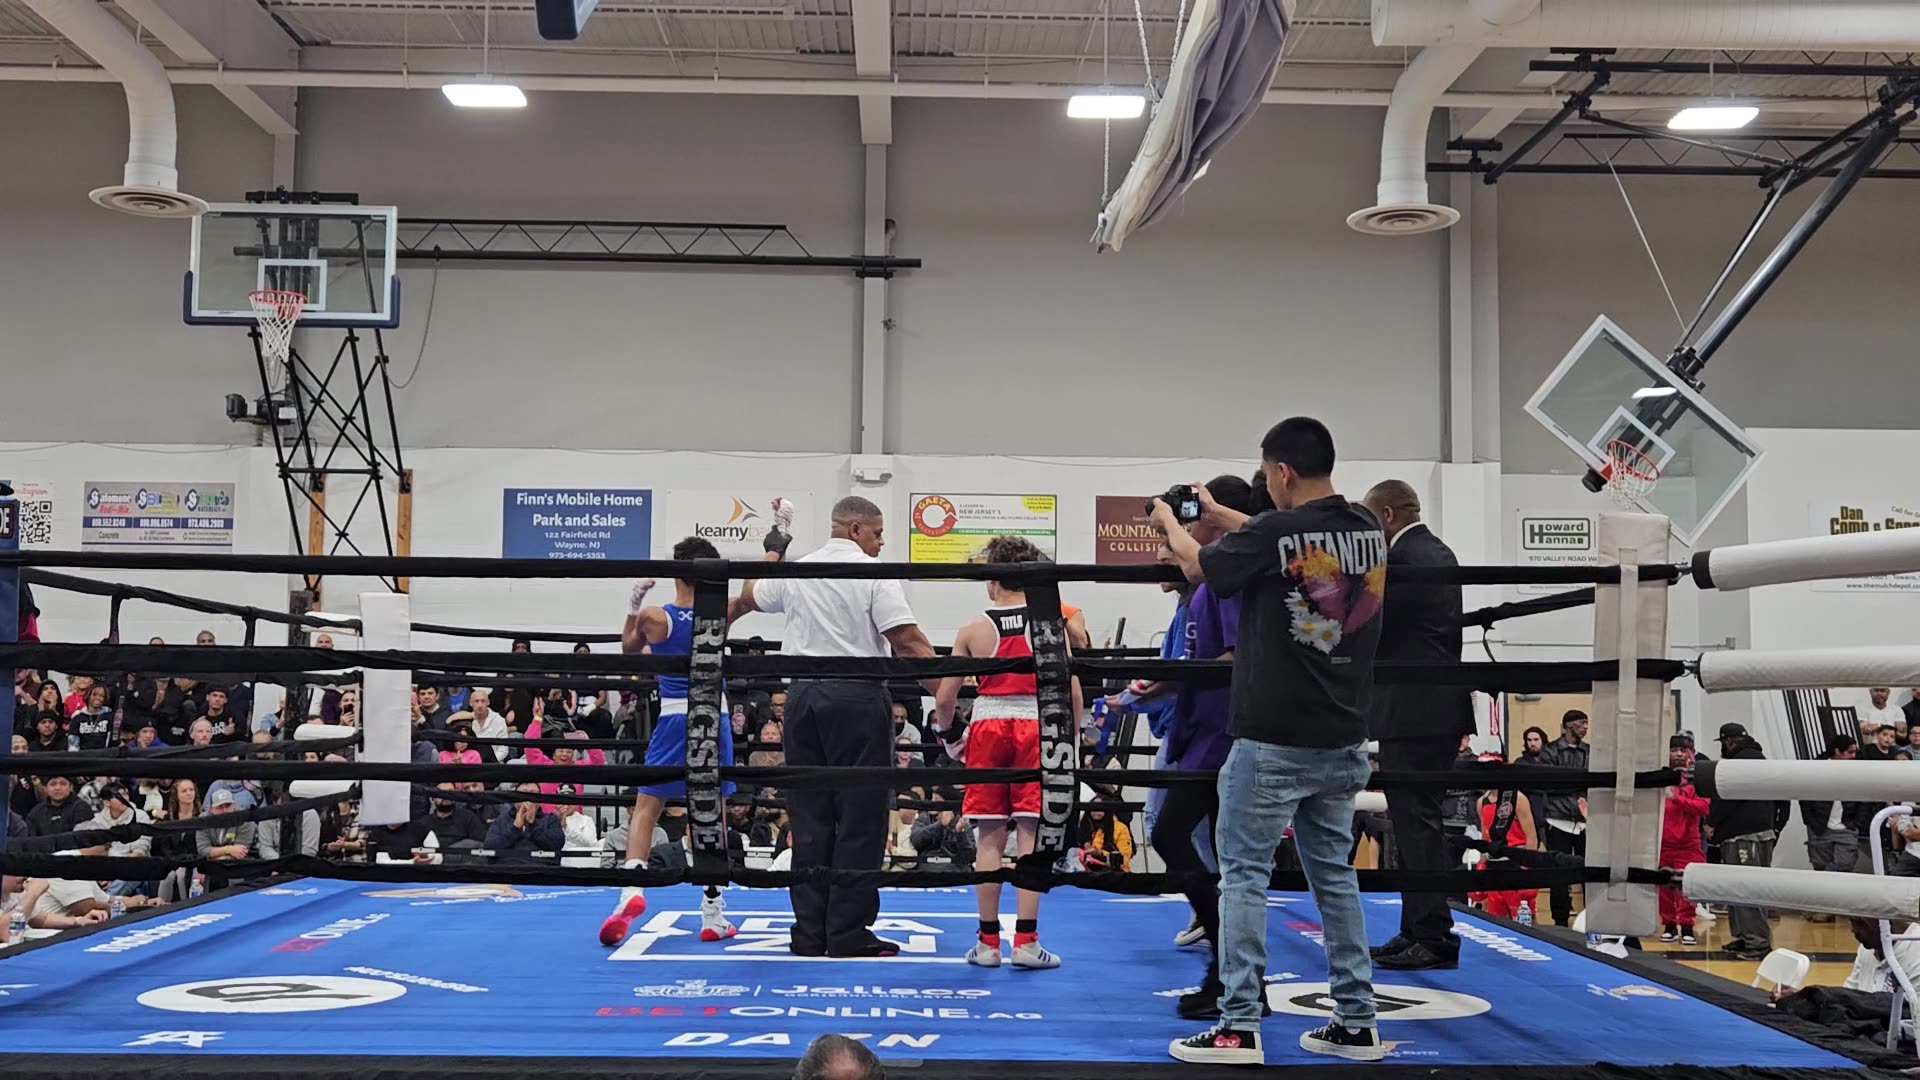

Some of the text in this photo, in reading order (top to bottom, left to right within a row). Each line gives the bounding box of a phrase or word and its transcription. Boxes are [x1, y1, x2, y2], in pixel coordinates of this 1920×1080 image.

[516, 492, 643, 506] Finn's Mobile Home
[918, 496, 952, 511] GAETA
[533, 513, 626, 527] Park and Sales
[1840, 506, 1863, 521] Dan
[561, 531, 597, 539] Fairfield
[1000, 615, 1024, 631] TITLE
[686, 615, 727, 851] RINGSIDE
[770, 985, 992, 996] Jalisco
